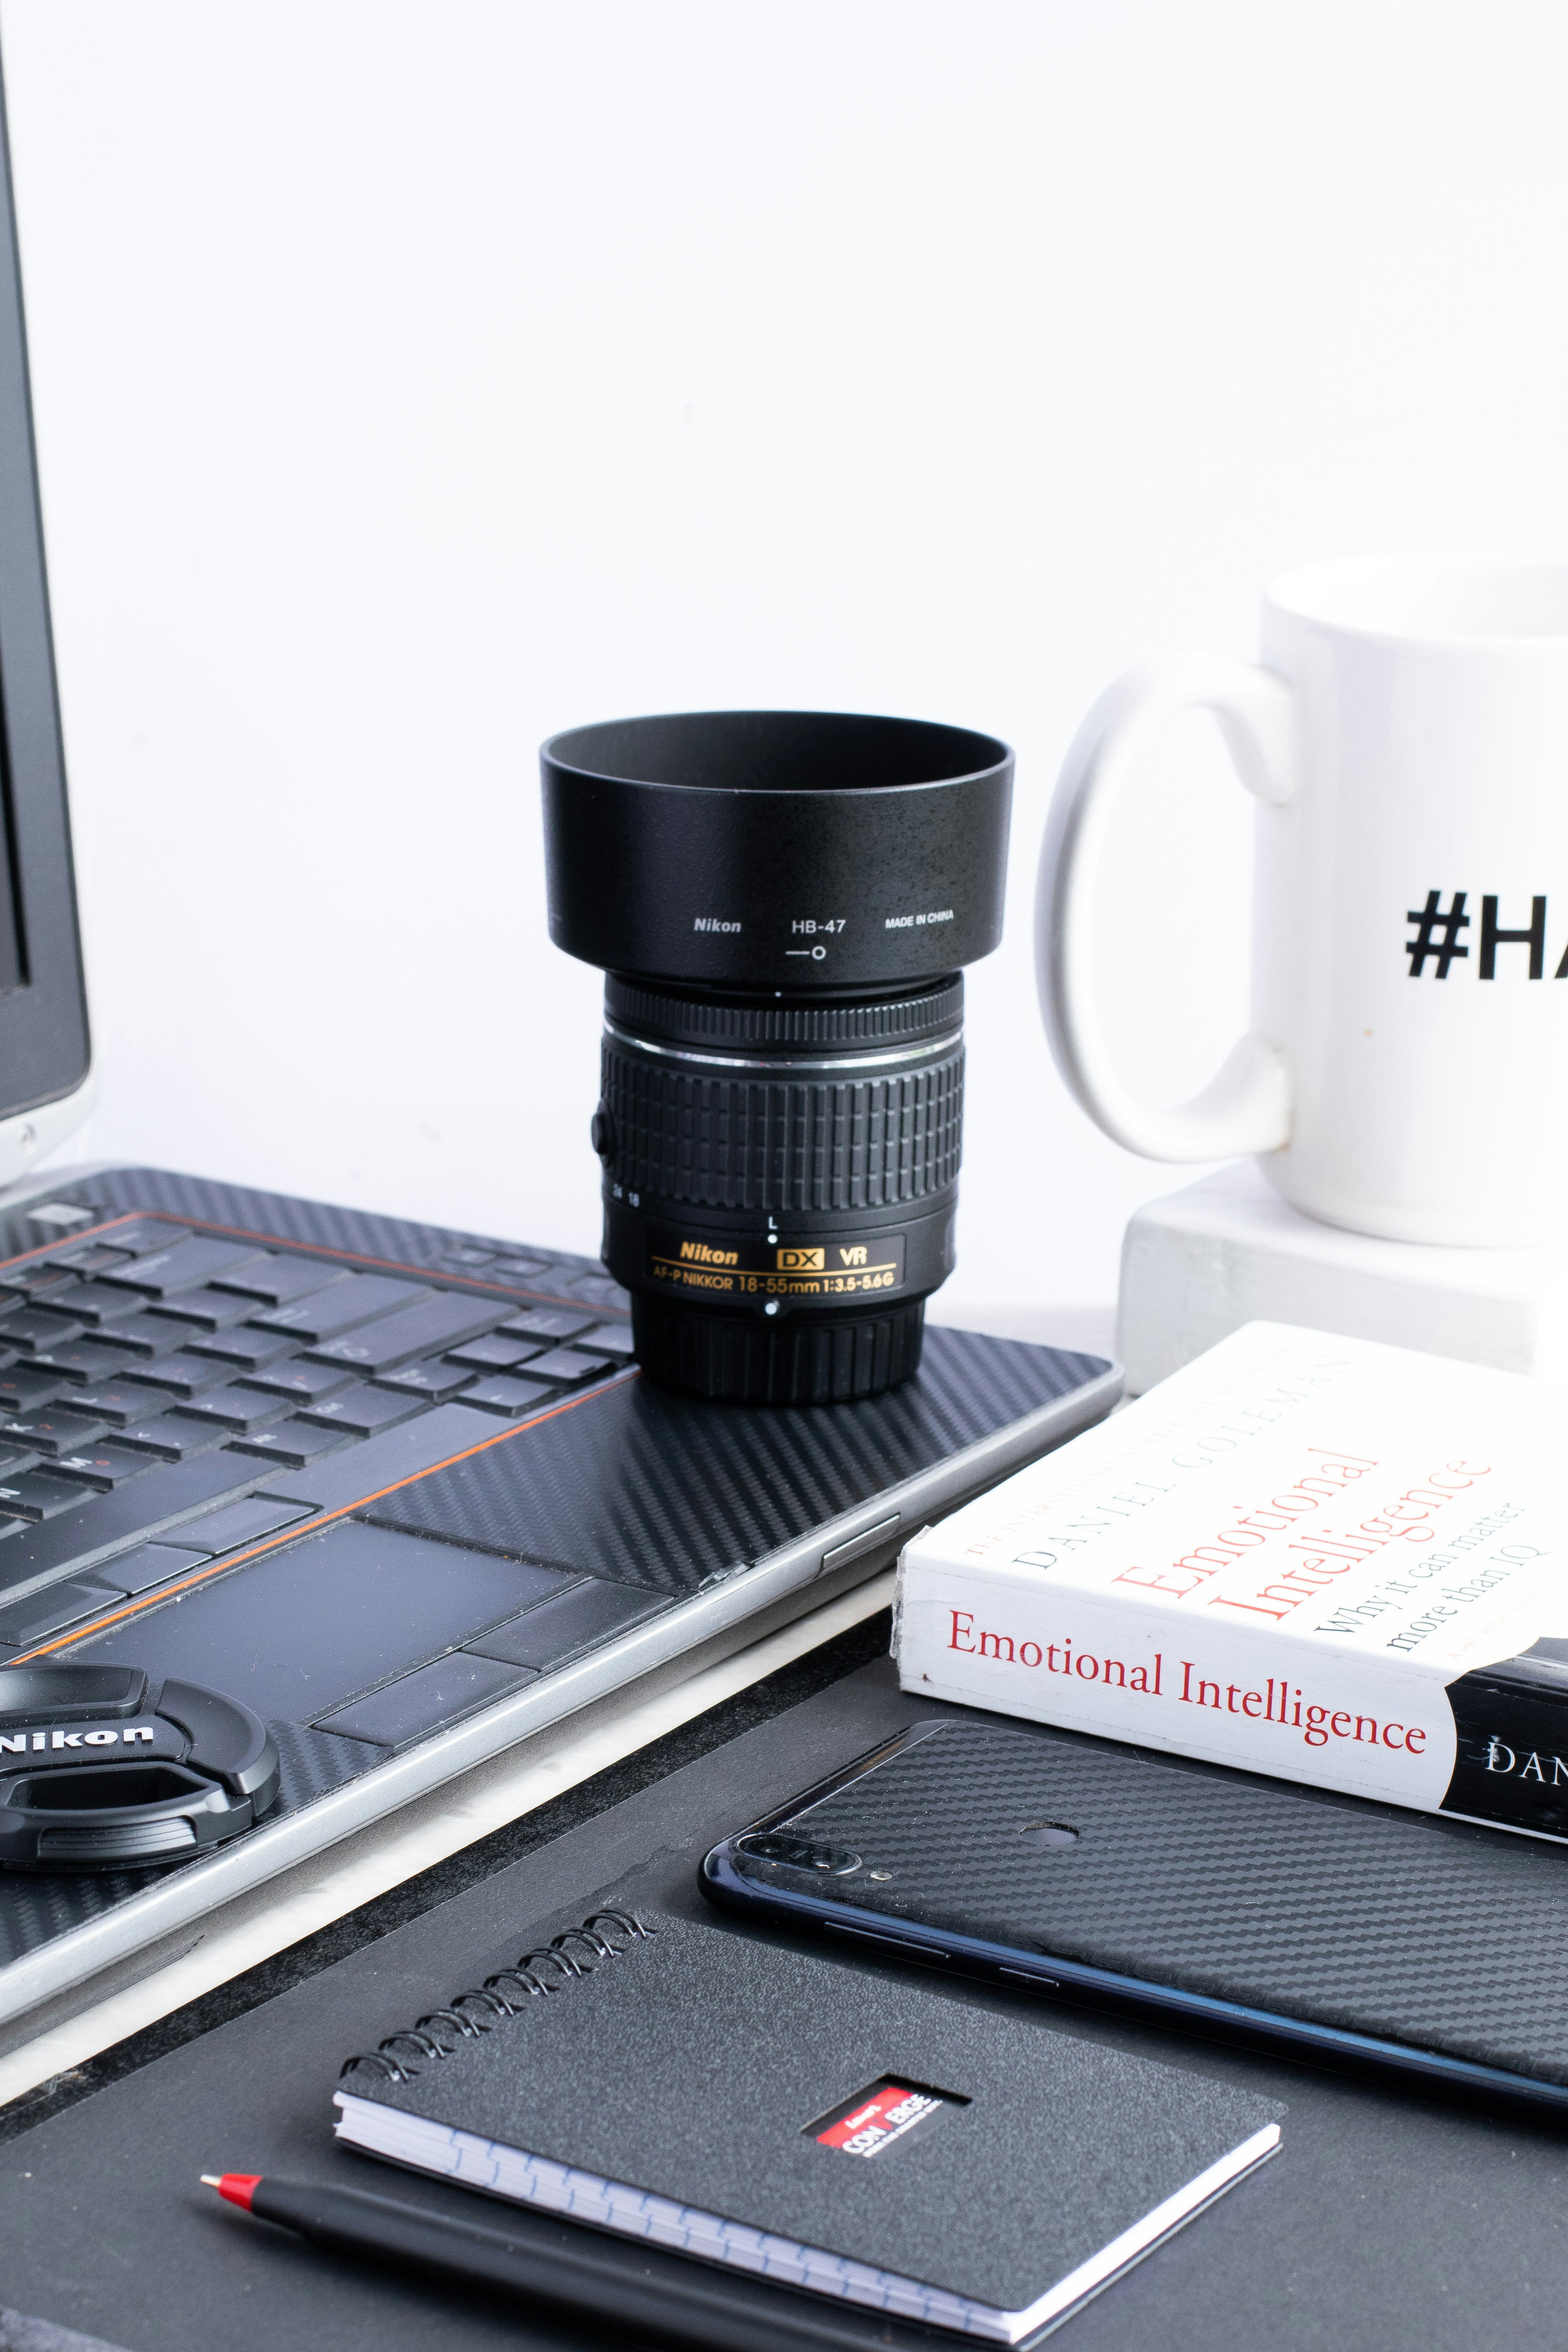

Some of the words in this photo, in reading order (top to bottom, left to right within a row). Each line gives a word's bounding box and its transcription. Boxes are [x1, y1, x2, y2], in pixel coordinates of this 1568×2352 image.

[693, 918, 741, 933] Nikon
[791, 919, 846, 934] HB-47
[885, 916, 914, 929] MADE
[915, 914, 926, 925] IN
[927, 909, 954, 924] CHINA
[1405, 889, 1568, 981] #H
[629, 1192, 640, 1208] 18
[768, 1216, 778, 1230] L
[653, 1265, 682, 1282] AF-P
[682, 1271, 734, 1291] NIKKOR
[739, 1275, 820, 1293] 18-55mm
[823, 1271, 894, 1293] 1:3.5-5.6G
[679, 1241, 739, 1265] Nikon
[781, 1251, 818, 1268] DX
[839, 1246, 868, 1266] VR
[964, 1530, 1006, 1556] THE
[1000, 1460, 1124, 1533] INTERNATIONAL
[1121, 1419, 1185, 1458] NUMBER
[1011, 1480, 1177, 1570] DANIEL
[1171, 1354, 1355, 1469] GOLEMAN
[1111, 1448, 1382, 1599] Emotional
[1207, 1460, 1492, 1621] Intelligence
[1314, 1595, 1403, 1633] Why
[1375, 1580, 1418, 1595] it
[1408, 1553, 1459, 1578] can
[1448, 1502, 1528, 1551] matter
[1386, 1605, 1458, 1653] more
[1441, 1568, 1512, 1603] than
[1488, 1544, 1554, 1568] IQ
[947, 1609, 1162, 1696] Emotional
[1179, 1661, 1427, 1754] Intelligence
[0, 1726, 154, 1753] Nikon
